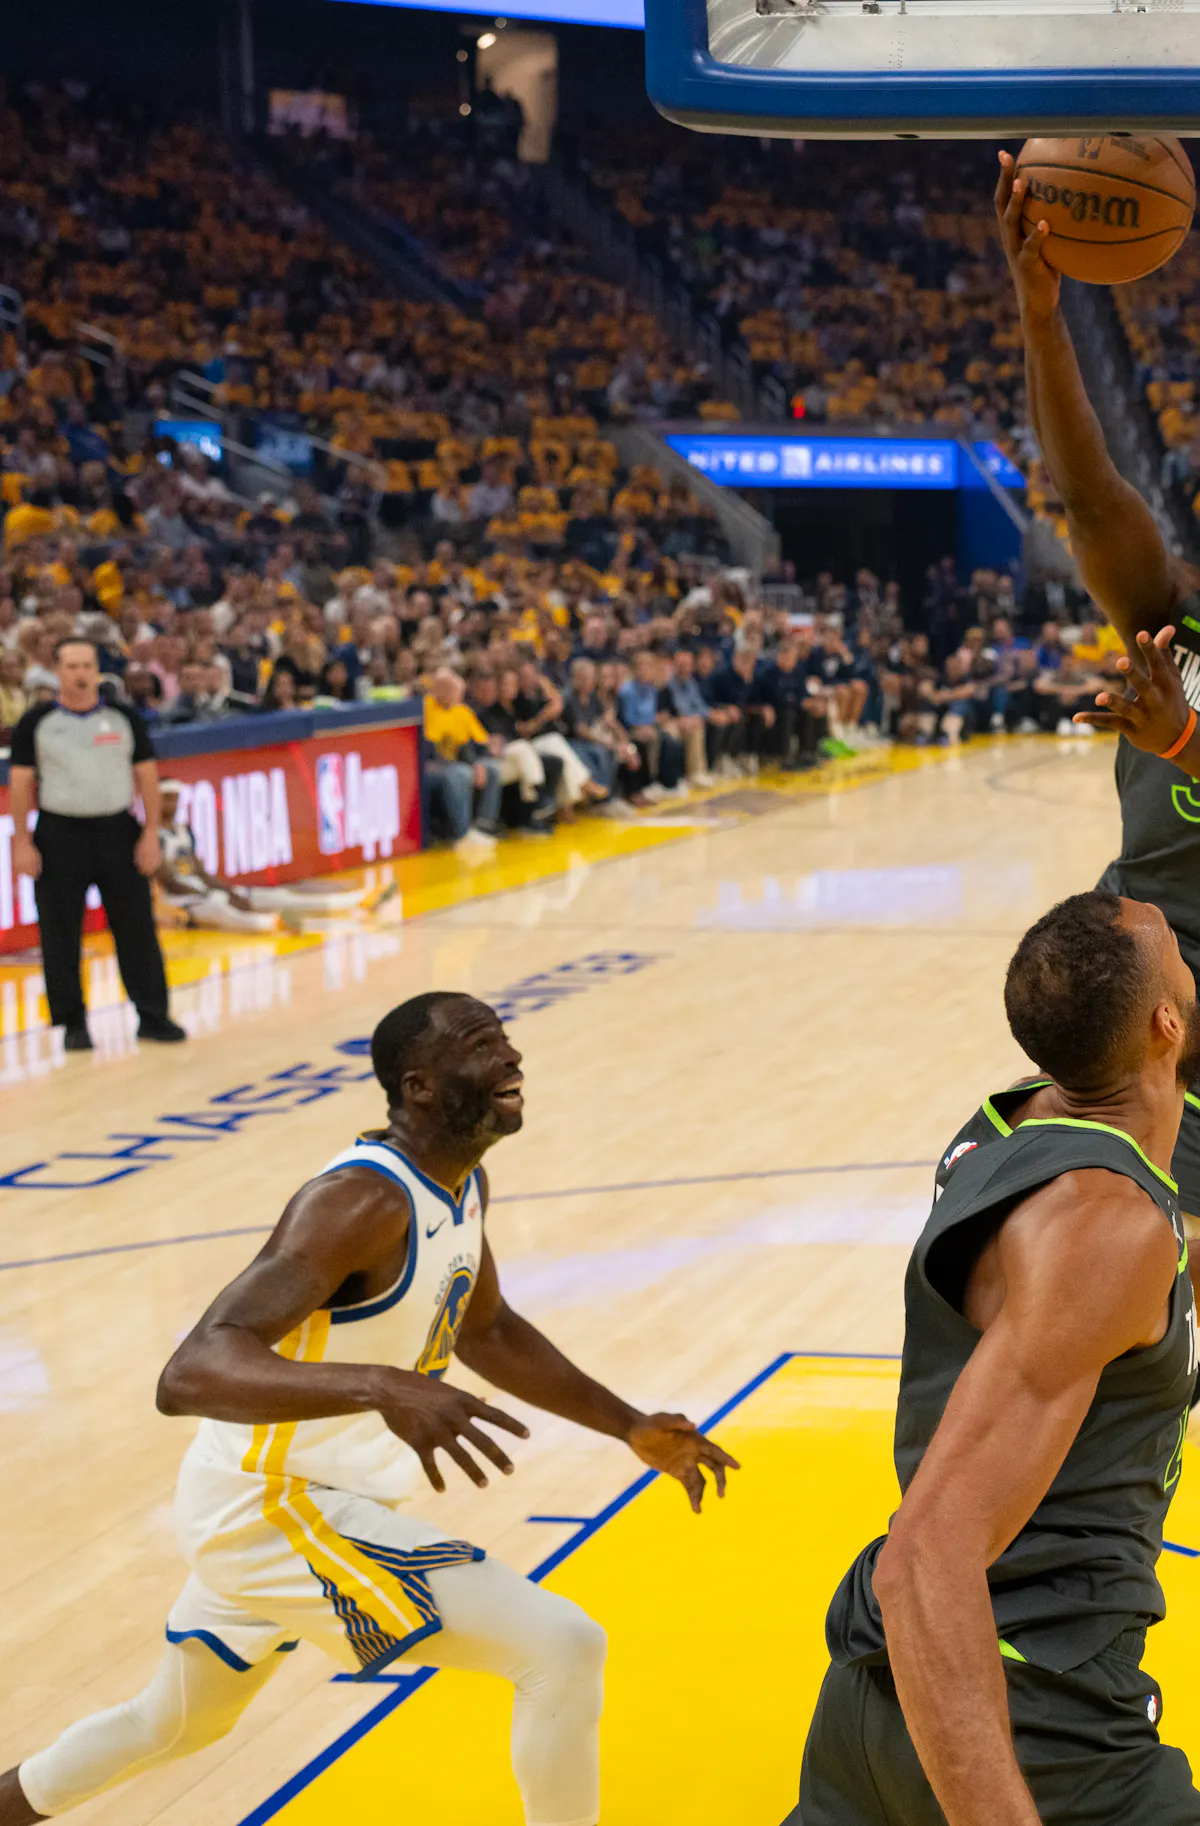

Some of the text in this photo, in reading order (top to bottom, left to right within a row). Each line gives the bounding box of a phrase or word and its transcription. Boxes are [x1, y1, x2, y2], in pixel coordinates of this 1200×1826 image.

[1025, 175, 1141, 229] Wilson
[814, 451, 944, 475] AIRLINES
[221, 767, 293, 878] NBA
[345, 751, 400, 862] App
